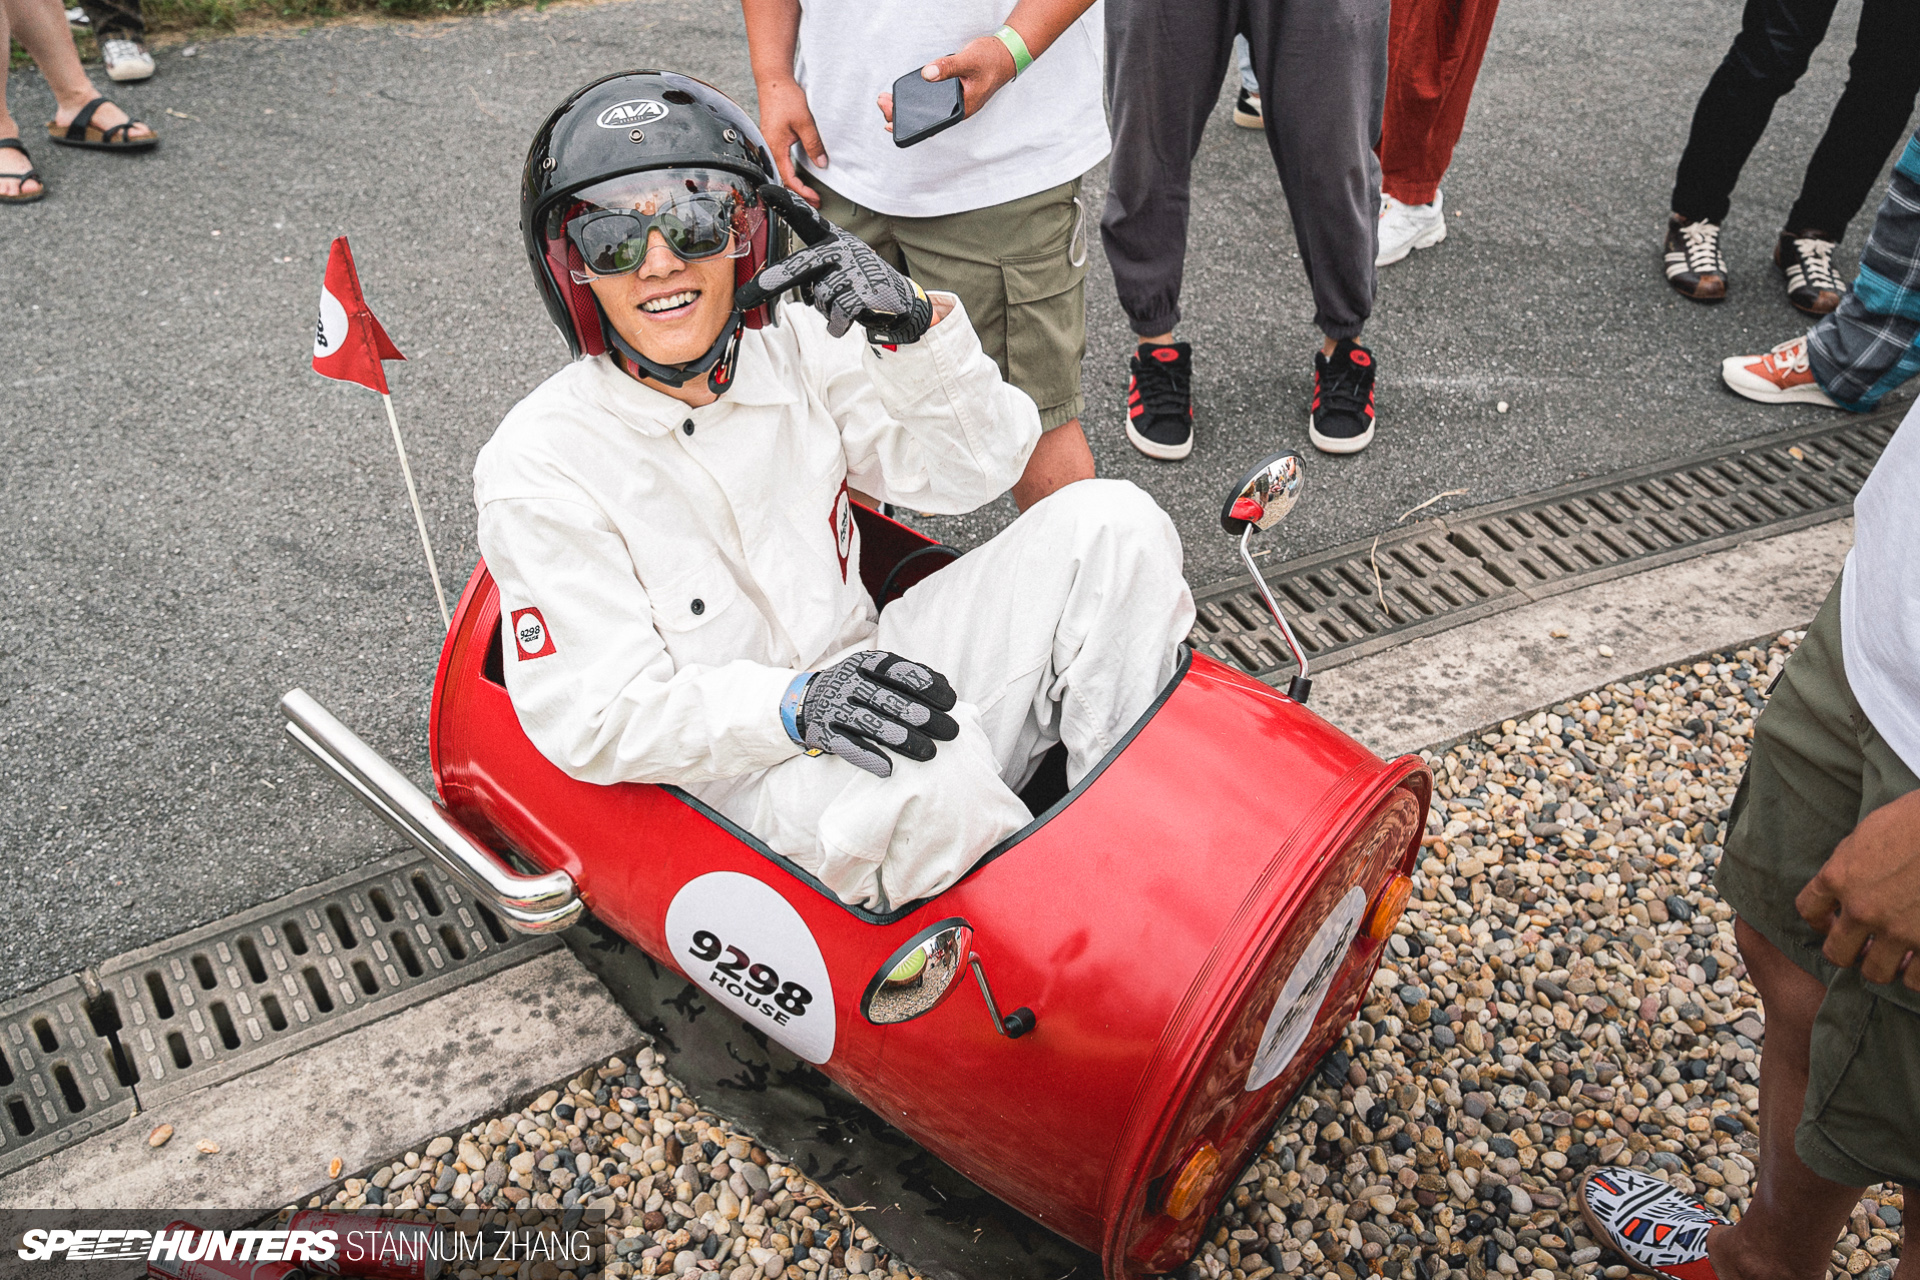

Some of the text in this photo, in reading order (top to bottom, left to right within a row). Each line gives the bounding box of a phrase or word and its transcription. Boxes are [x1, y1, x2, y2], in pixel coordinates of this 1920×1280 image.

[604, 102, 662, 124] AVA
[520, 625, 540, 640] 9298
[688, 930, 813, 1016] 9298
[709, 971, 790, 1027] HOUSE
